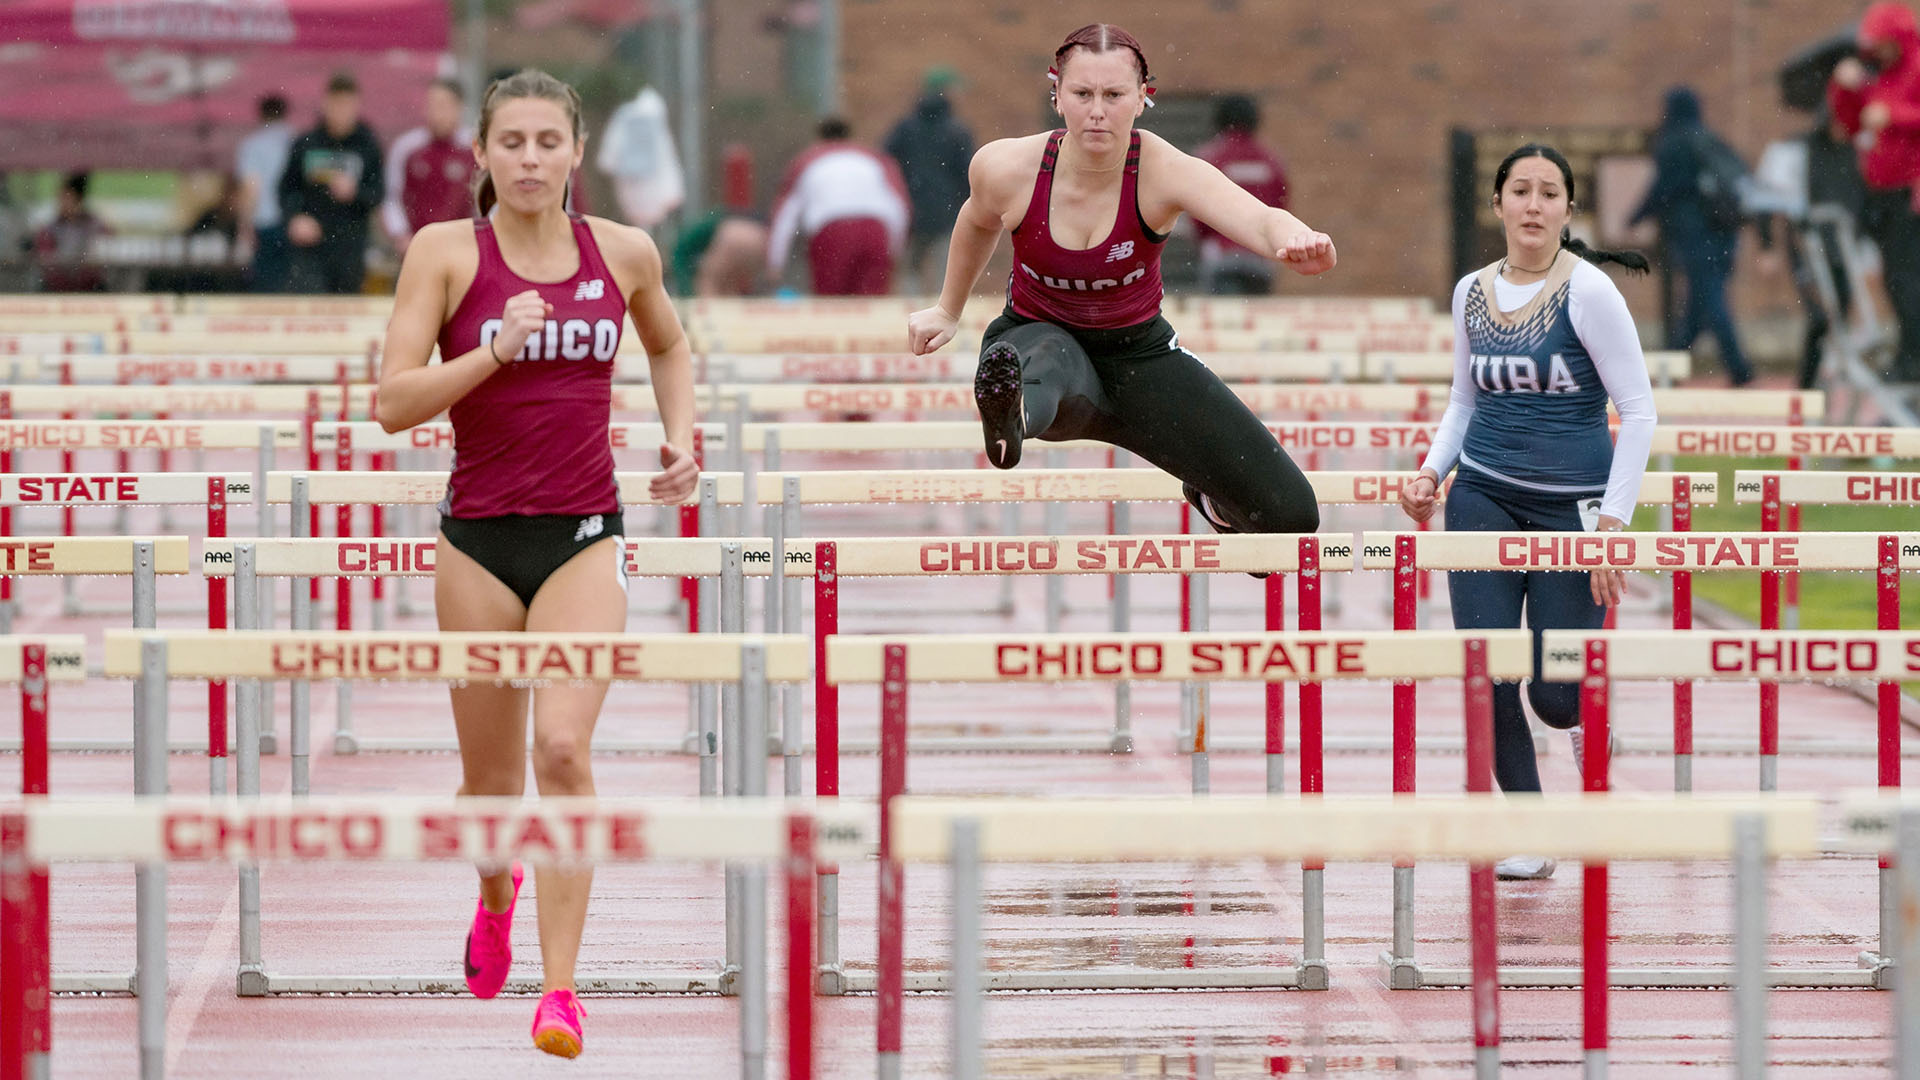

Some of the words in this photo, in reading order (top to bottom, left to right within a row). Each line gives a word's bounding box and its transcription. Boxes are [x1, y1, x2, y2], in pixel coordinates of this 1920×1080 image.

[1470, 353, 1580, 394] UBA
[804, 389, 892, 409] CHICO
[0, 425, 84, 445] HICO
[101, 425, 204, 446] STATE
[1677, 431, 1776, 454] CHICO
[1791, 432, 1894, 454] STATE
[18, 477, 139, 501] STATE
[919, 541, 1058, 572] CHICO
[1076, 539, 1221, 570] STATE
[1498, 536, 1637, 567] CHICO
[1655, 536, 1800, 567] STATE
[271, 641, 442, 675] CHICO
[466, 641, 643, 677] STATE
[996, 642, 1164, 676] CHICO
[1190, 641, 1366, 673] STATE
[1711, 639, 1879, 672] CHICO
[162, 811, 386, 860] CHICO
[418, 812, 649, 860] STATE
